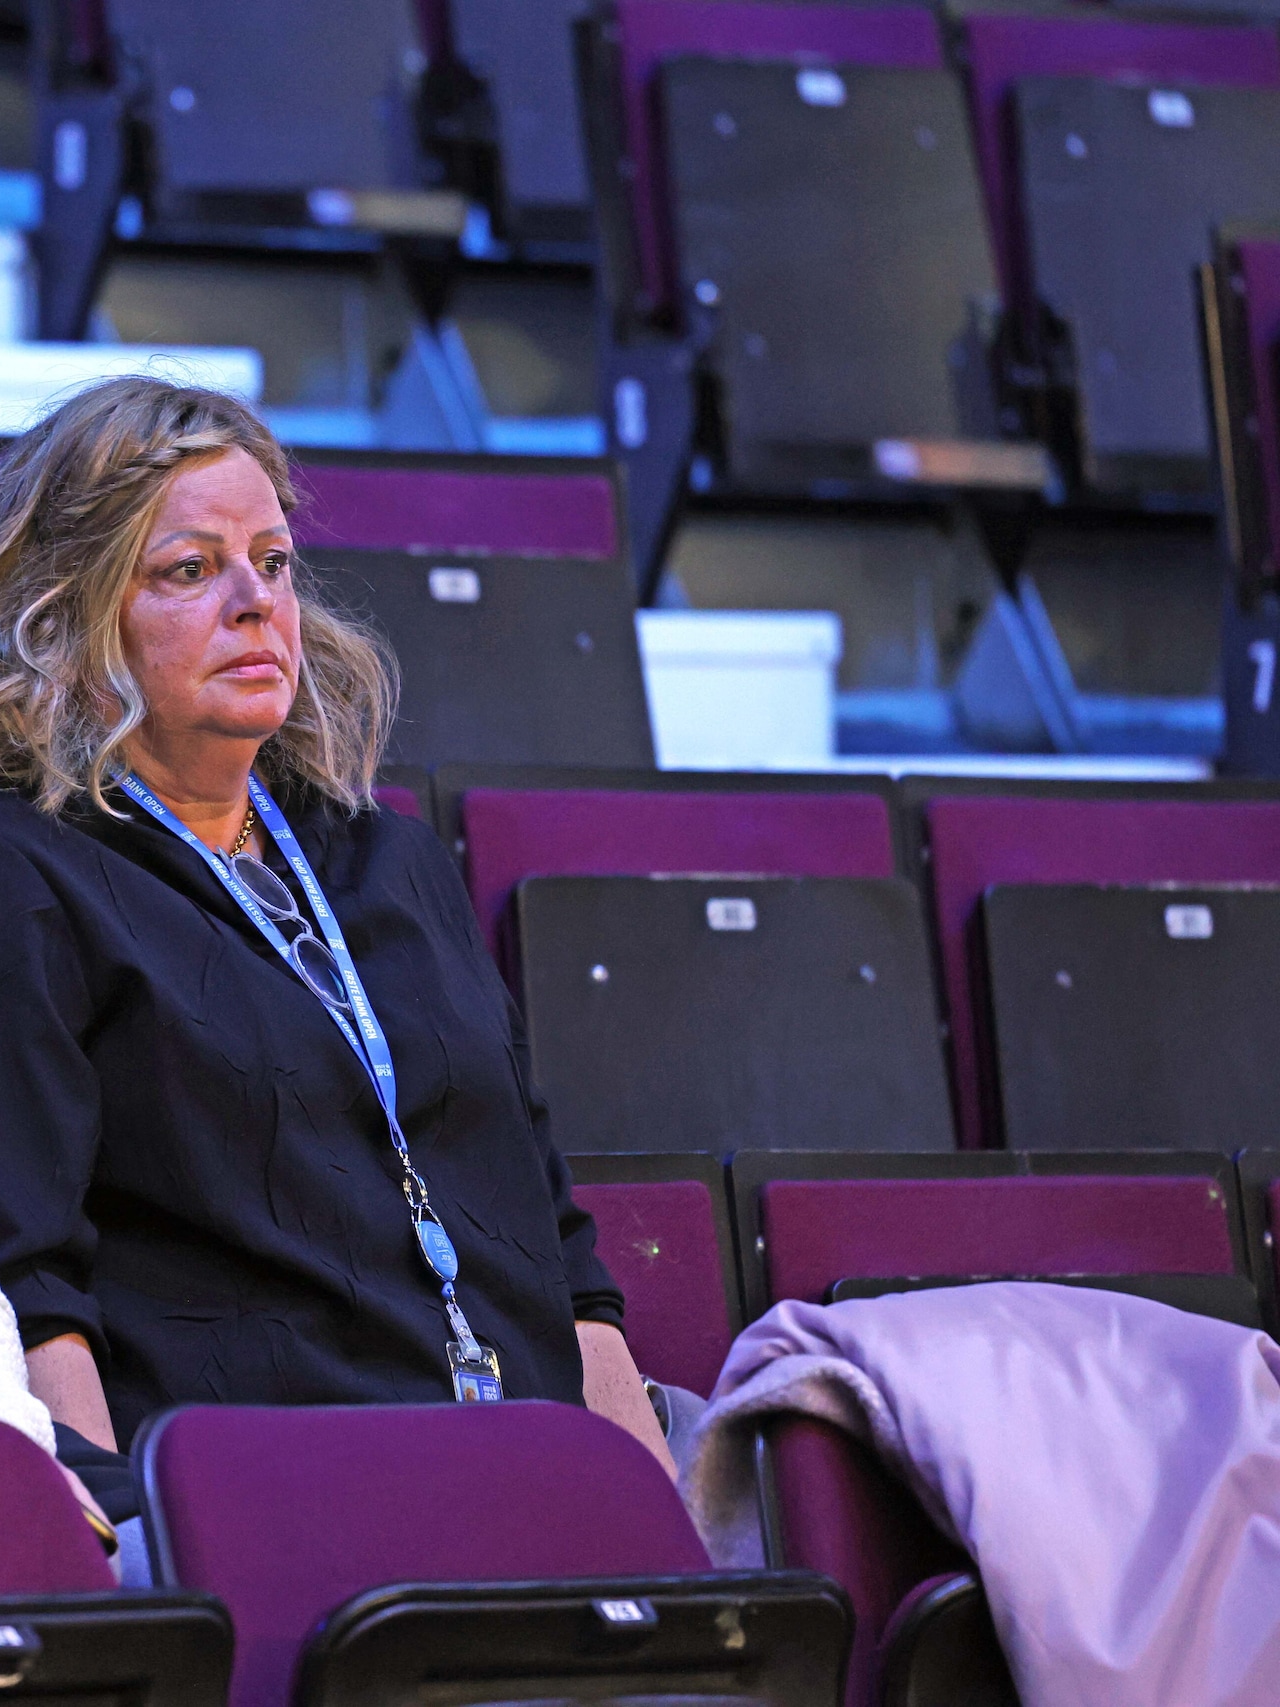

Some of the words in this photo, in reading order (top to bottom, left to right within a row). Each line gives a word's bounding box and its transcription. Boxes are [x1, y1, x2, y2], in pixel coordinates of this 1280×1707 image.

[122, 776, 147, 798] BANK
[143, 795, 166, 815] OPEN
[255, 794, 272, 812] OPEN
[211, 858, 230, 879] OPEN
[291, 856, 308, 876] OPEN
[227, 878, 248, 901] BANK
[301, 874, 318, 895] BANK
[244, 901, 267, 926] ERSTE
[311, 894, 330, 918] ERSTE
[343, 969, 361, 995] ERSTE
[352, 994, 369, 1017] BANK
[361, 1018, 378, 1040] OPEN
[342, 1023, 359, 1046] OPEN
